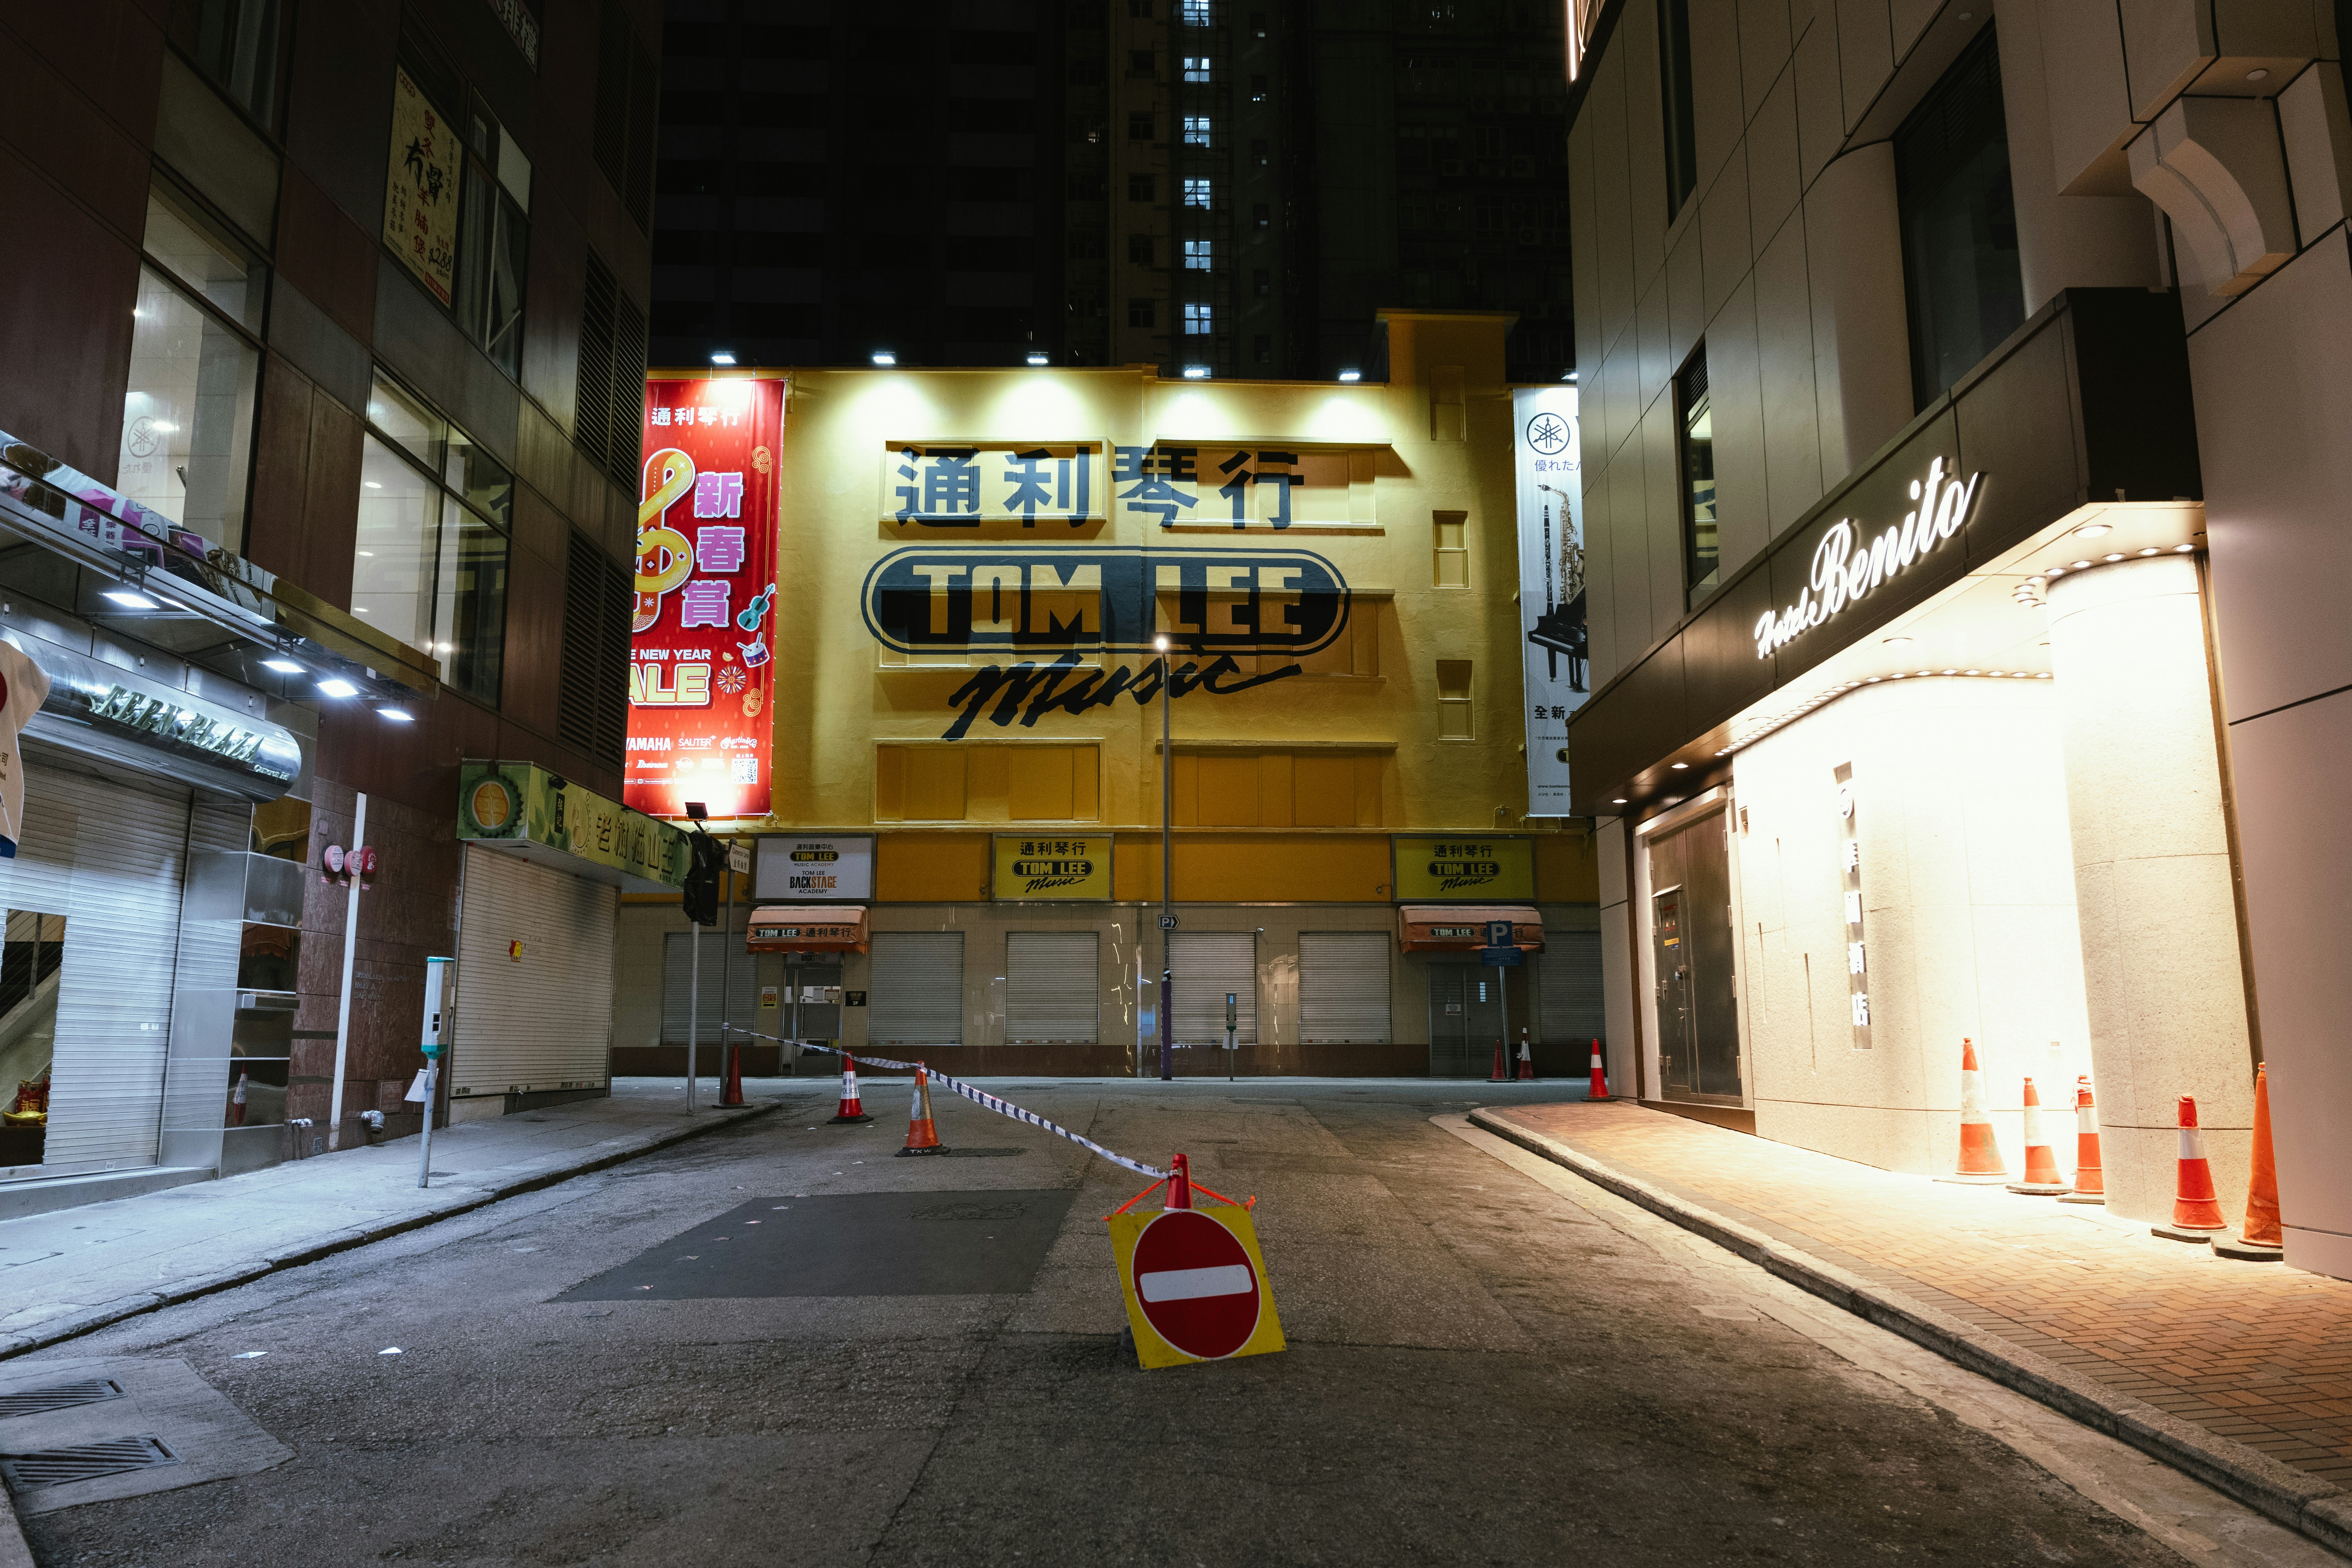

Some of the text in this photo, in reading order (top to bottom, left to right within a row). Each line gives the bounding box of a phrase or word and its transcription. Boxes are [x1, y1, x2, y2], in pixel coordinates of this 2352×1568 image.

[428, 247, 452, 272] $288
[651, 407, 741, 426] 通利琴行
[895, 446, 1304, 530] 通利琴行
[681, 471, 744, 627] 新春賞
[1755, 456, 1978, 659] Hotel Benito
[913, 564, 1302, 635] TOM LEE
[640, 649, 669, 661] NEW
[673, 649, 711, 661] YEAR
[941, 644, 1303, 742] Music
[1534, 705, 1578, 720] 全新
[177, 713, 265, 763] PLAZA
[626, 737, 671, 751] YAMAHA
[679, 738, 712, 746] SAUTER
[732, 848, 743, 857] Cameron
[1020, 842, 1086, 856] 通利琴行
[1434, 845, 1493, 858] 通利琴行
[1020, 862, 1085, 875] TOM LEE
[1435, 864, 1494, 875] TOM LEE
[790, 876, 837, 889] BACKSTAGE
[1025, 875, 1086, 893] Music
[1440, 875, 1494, 891] Music
[1162, 918, 1169, 927] P
[806, 927, 852, 937] 通利琴行
[1491, 924, 1508, 944] P
